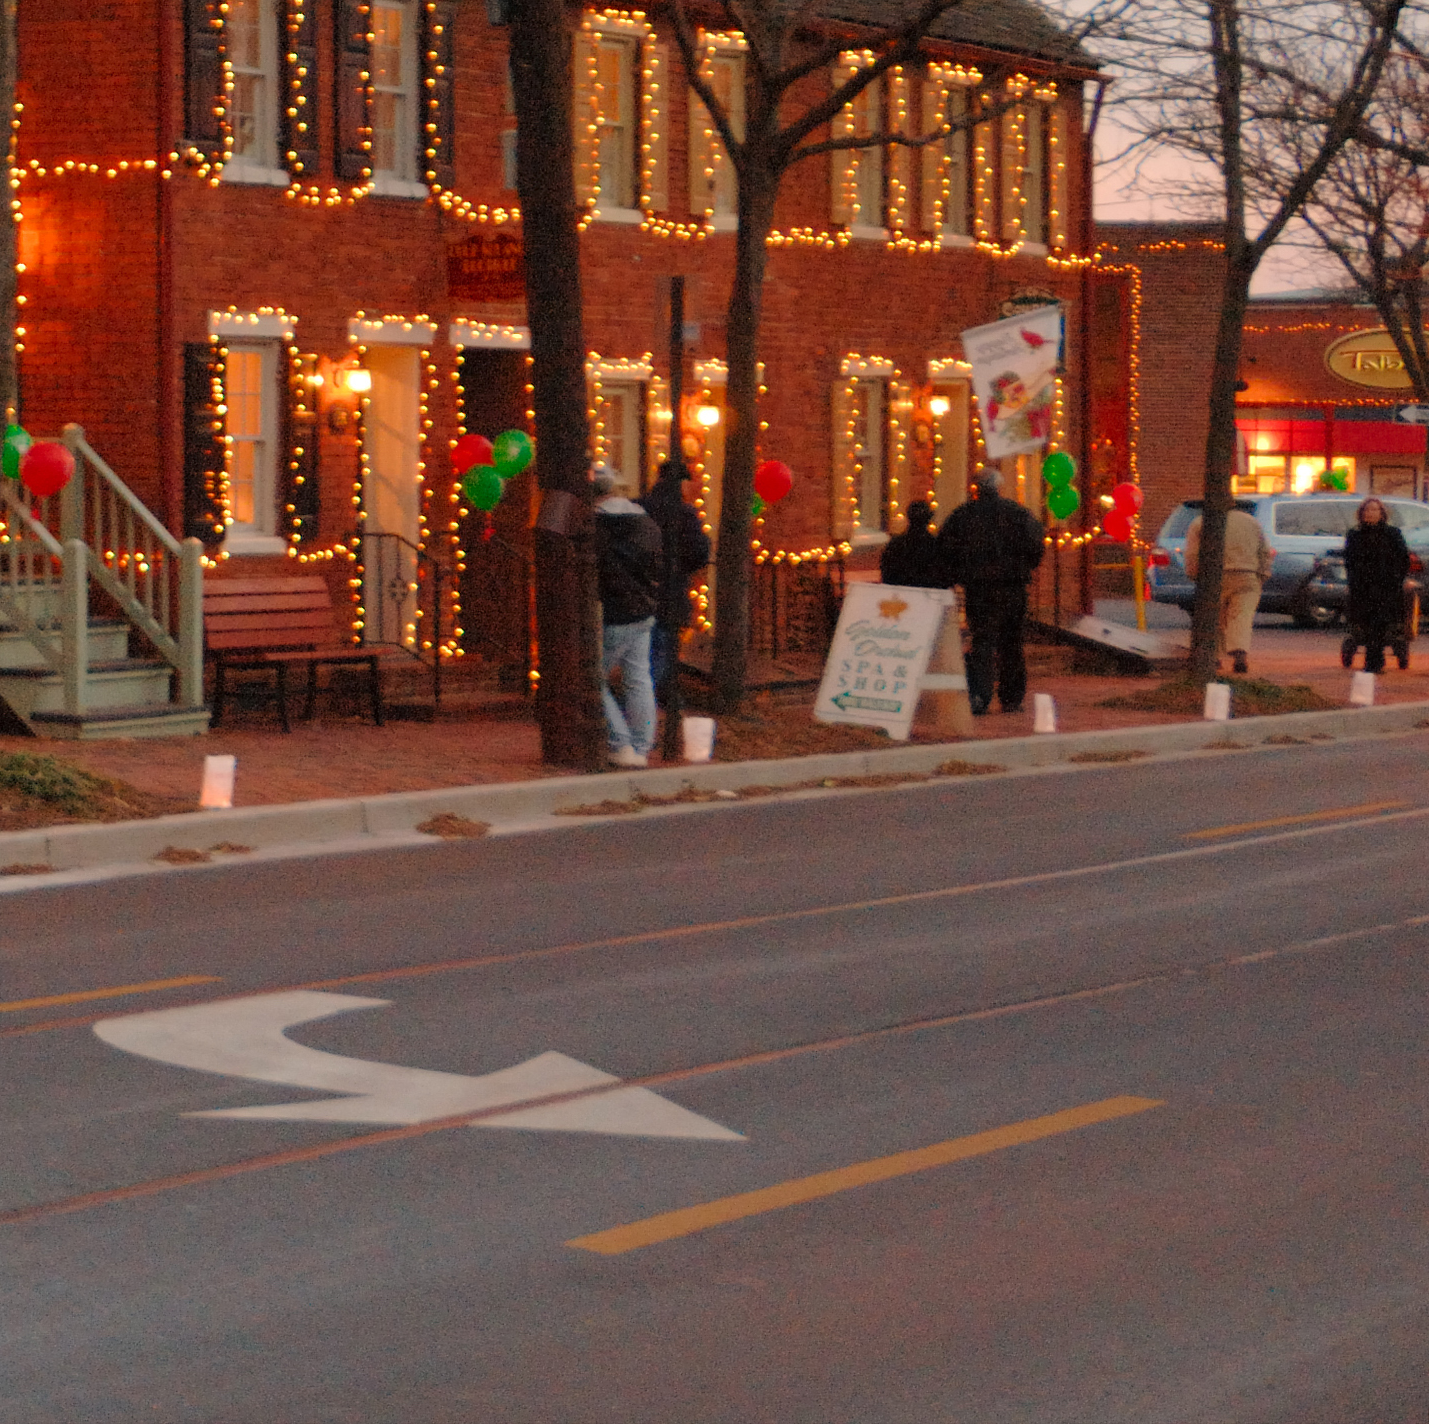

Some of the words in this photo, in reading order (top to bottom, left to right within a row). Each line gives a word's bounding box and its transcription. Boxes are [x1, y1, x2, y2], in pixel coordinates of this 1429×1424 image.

[841, 659, 883, 676] SPA
[893, 665, 908, 678] &
[837, 674, 907, 694] SHOP
